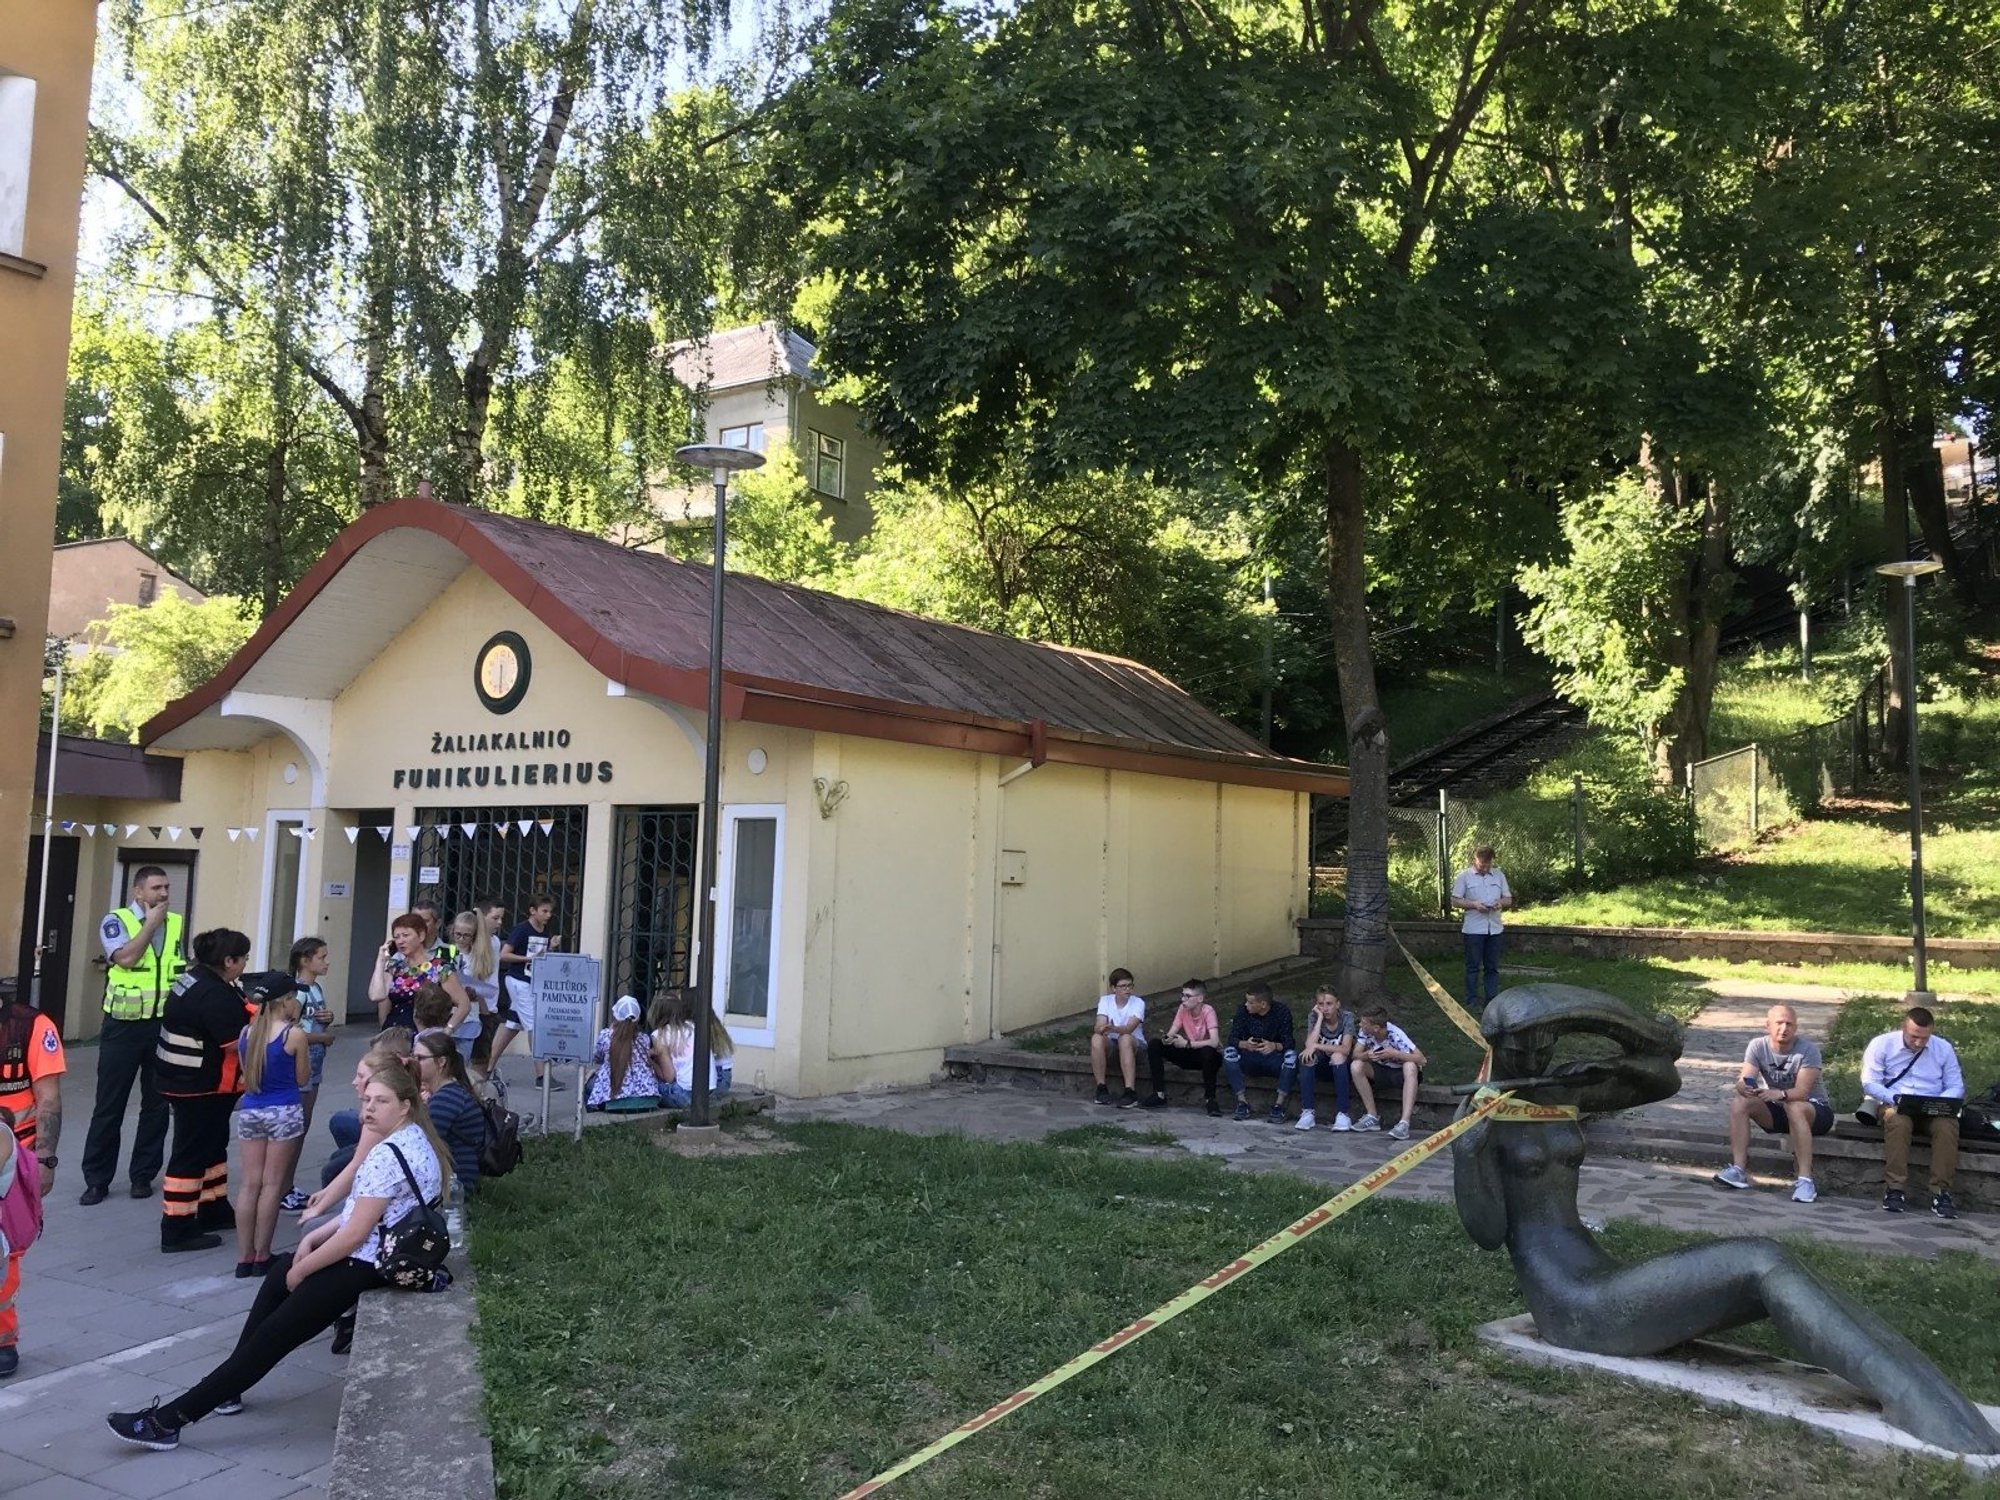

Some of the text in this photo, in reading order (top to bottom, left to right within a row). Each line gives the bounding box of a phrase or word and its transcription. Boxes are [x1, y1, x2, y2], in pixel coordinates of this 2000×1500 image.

[431, 729, 571, 754] ŽALIAKALNIO
[393, 761, 614, 789] FUNIKULIERIUS
[543, 980, 588, 992] KULTŪROS
[542, 993, 588, 1004] PAMINKLAS
